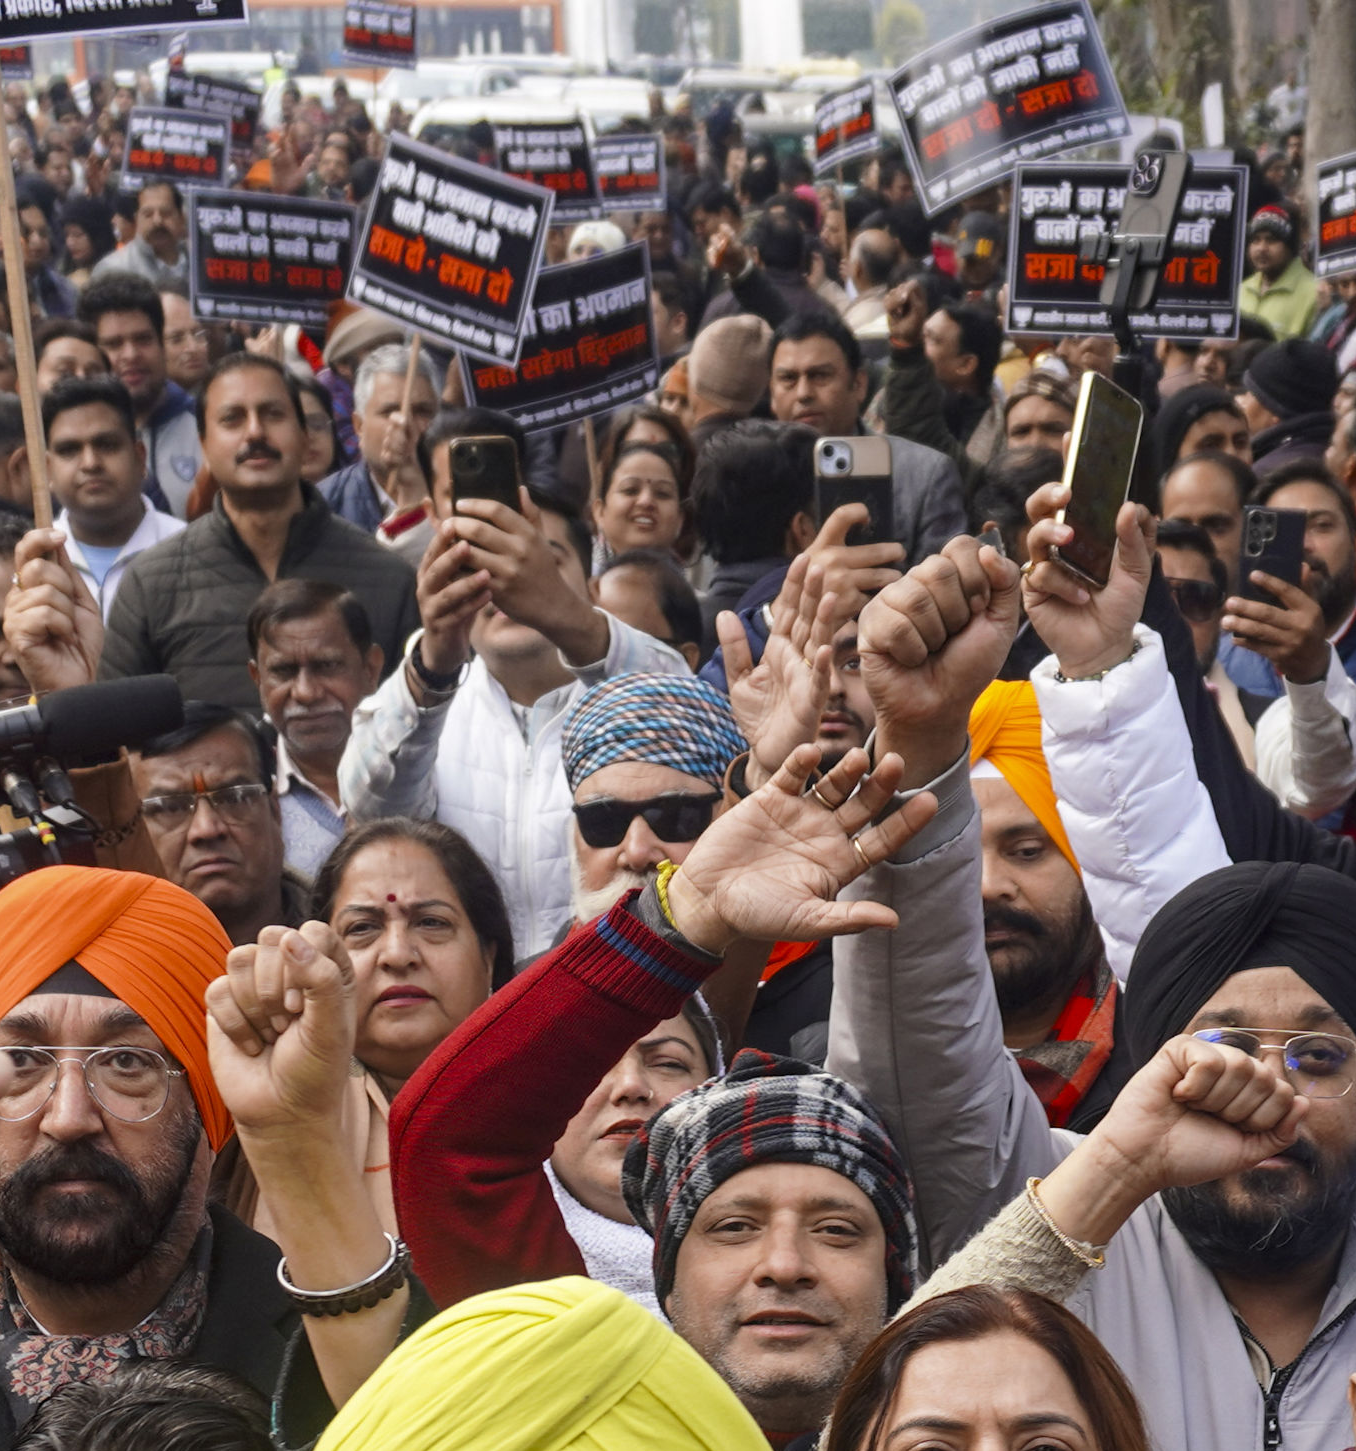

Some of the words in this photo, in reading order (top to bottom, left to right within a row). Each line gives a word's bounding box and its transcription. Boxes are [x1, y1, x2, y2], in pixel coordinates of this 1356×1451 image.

[1077, 187, 1105, 212] का
[1182, 185, 1235, 215] करने
[1025, 253, 1078, 281] सजा
[1191, 250, 1221, 283] दो
[538, 301, 572, 331] का
[576, 278, 646, 321] अपमान
